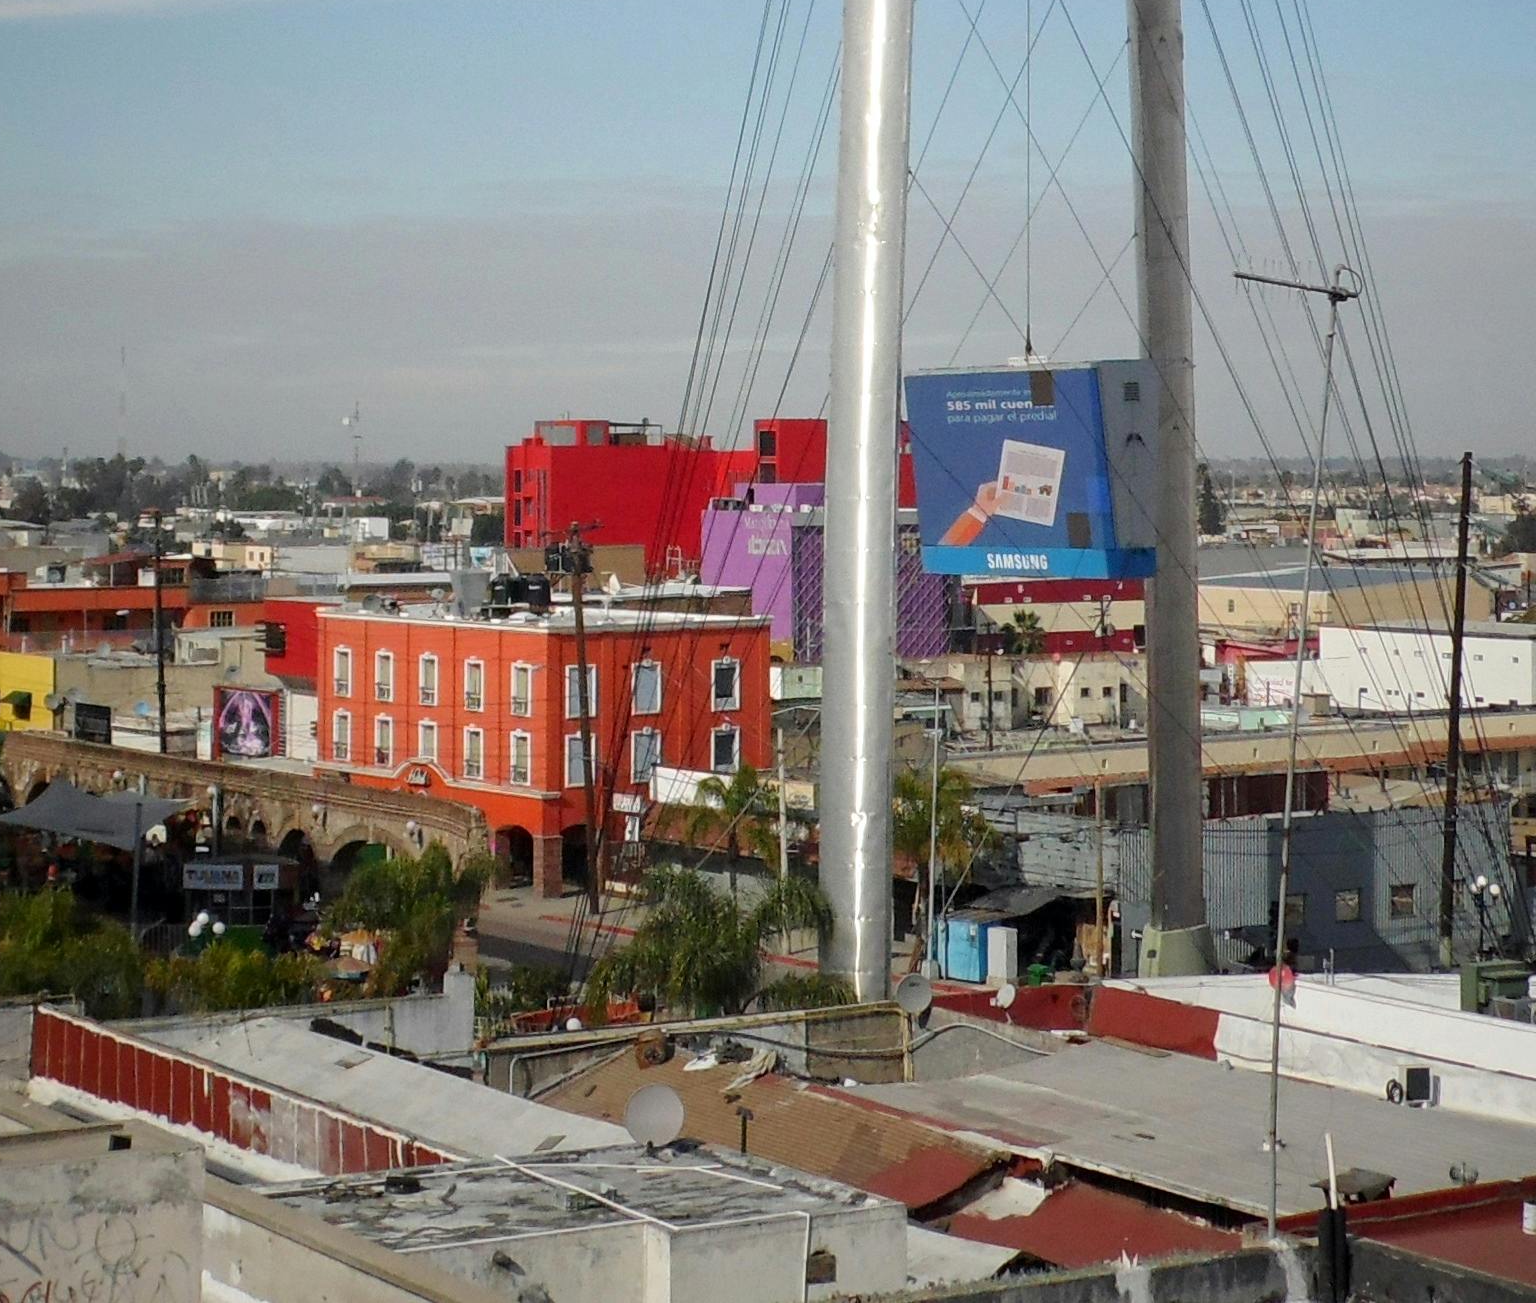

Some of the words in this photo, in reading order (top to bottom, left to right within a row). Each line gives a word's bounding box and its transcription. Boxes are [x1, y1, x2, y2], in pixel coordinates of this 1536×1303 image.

[947, 401, 971, 411] 585
[975, 400, 996, 410] mil
[987, 552, 1048, 570] SAMSUNG
